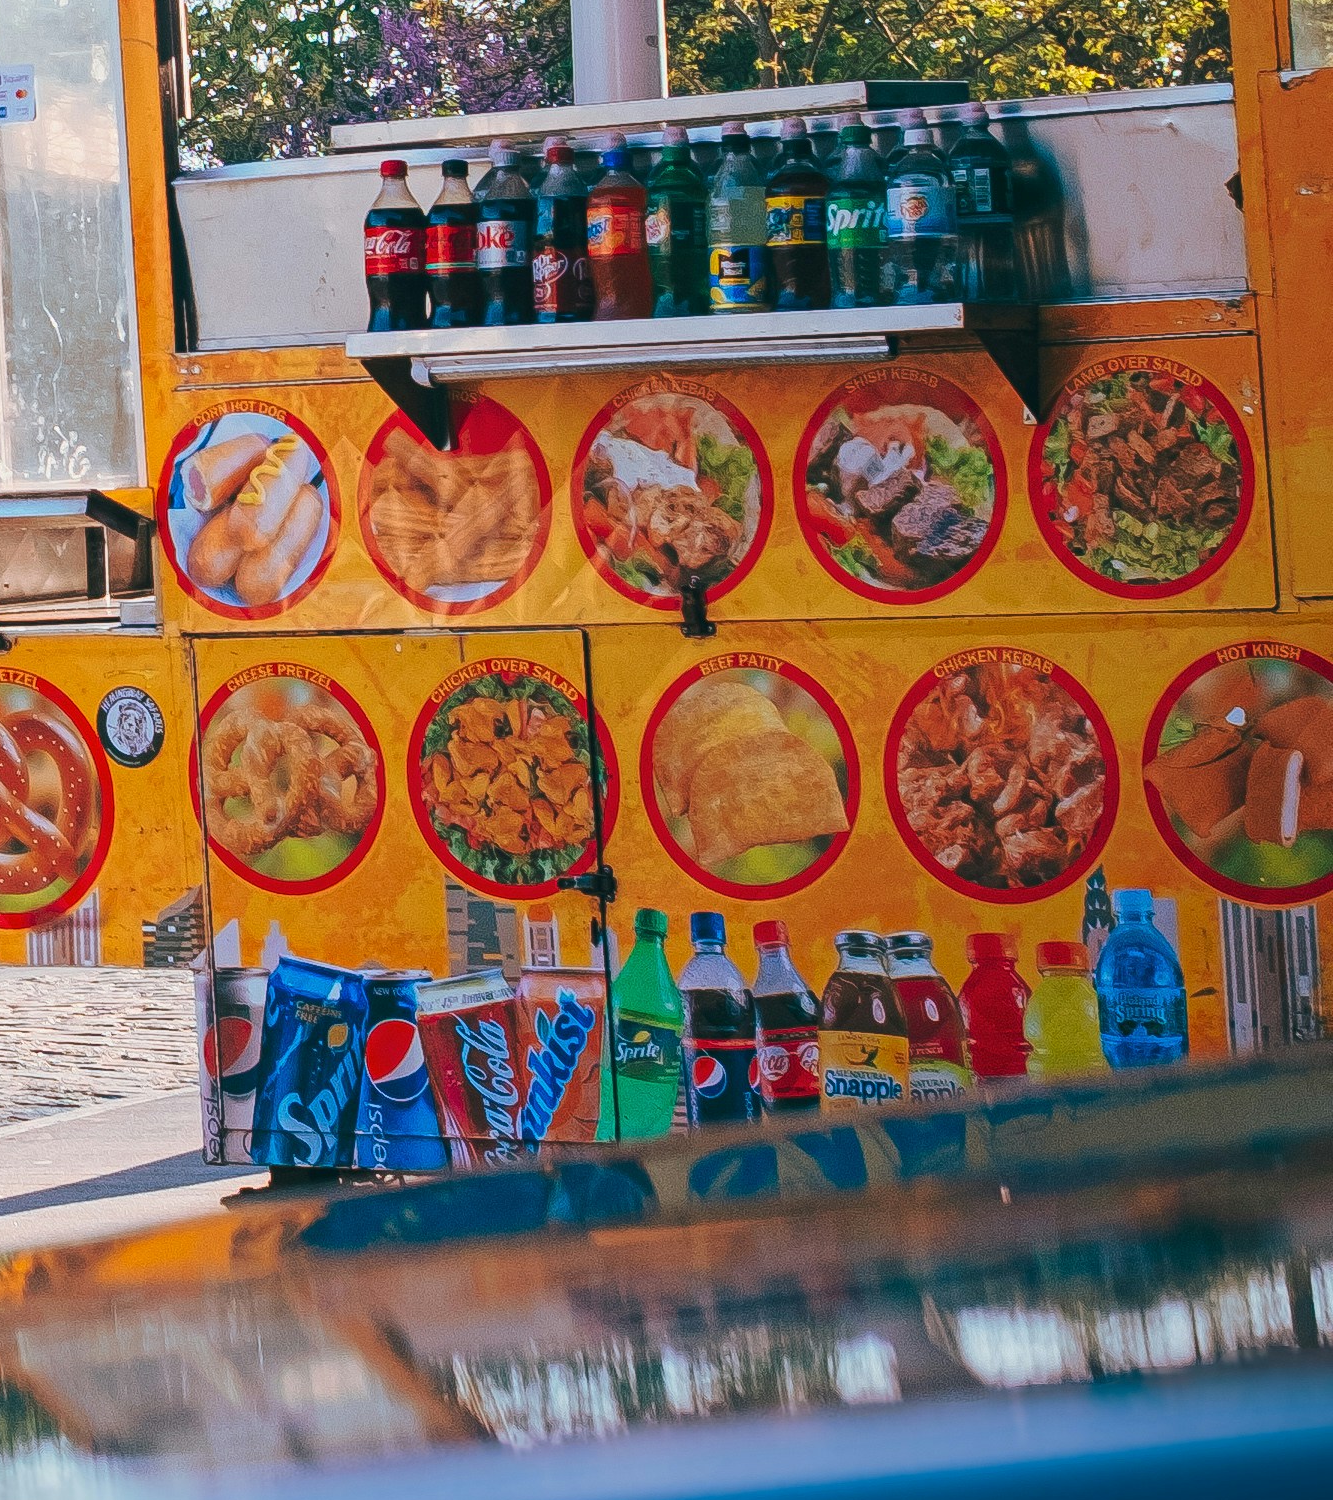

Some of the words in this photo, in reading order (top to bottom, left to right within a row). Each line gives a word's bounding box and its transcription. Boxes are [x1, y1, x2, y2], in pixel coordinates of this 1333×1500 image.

[827, 200, 885, 236] Sprit
[477, 226, 516, 250] oke
[845, 368, 888, 394] SHISH
[891, 367, 941, 388] KEBAB
[1064, 364, 1105, 395] LAMB
[1107, 355, 1148, 373] OVER
[1151, 357, 1204, 388] SALAD
[612, 380, 669, 409] CHICKEN
[671, 381, 717, 402] KEBAB
[193, 401, 229, 427] CORN
[230, 400, 257, 412] HOT
[258, 402, 288, 423] DOG
[699, 654, 734, 676] BEEF
[738, 654, 785, 672] PATTY
[934, 649, 998, 679] CHICKEN
[1001, 650, 1054, 676] KEBAB
[1216, 644, 1247, 664] HOT
[1252, 643, 1302, 661] KNISH
[227, 663, 276, 693] CHEESE
[277, 664, 333, 692] PRETZEL
[431, 662, 488, 703] CHICKEN
[491, 659, 531, 675] OVER
[531, 665, 580, 702] SALAD
[373, 987, 389, 996] NEW
[1116, 1005, 1167, 1025] Spring
[615, 1041, 661, 1063] Sprite
[450, 1012, 524, 1169] Coca-Cola
[825, 1069, 903, 1105] Snapple
[910, 1081, 967, 1102] apple
[277, 1050, 358, 1166] Spri
[203, 1097, 221, 1164] epsi
